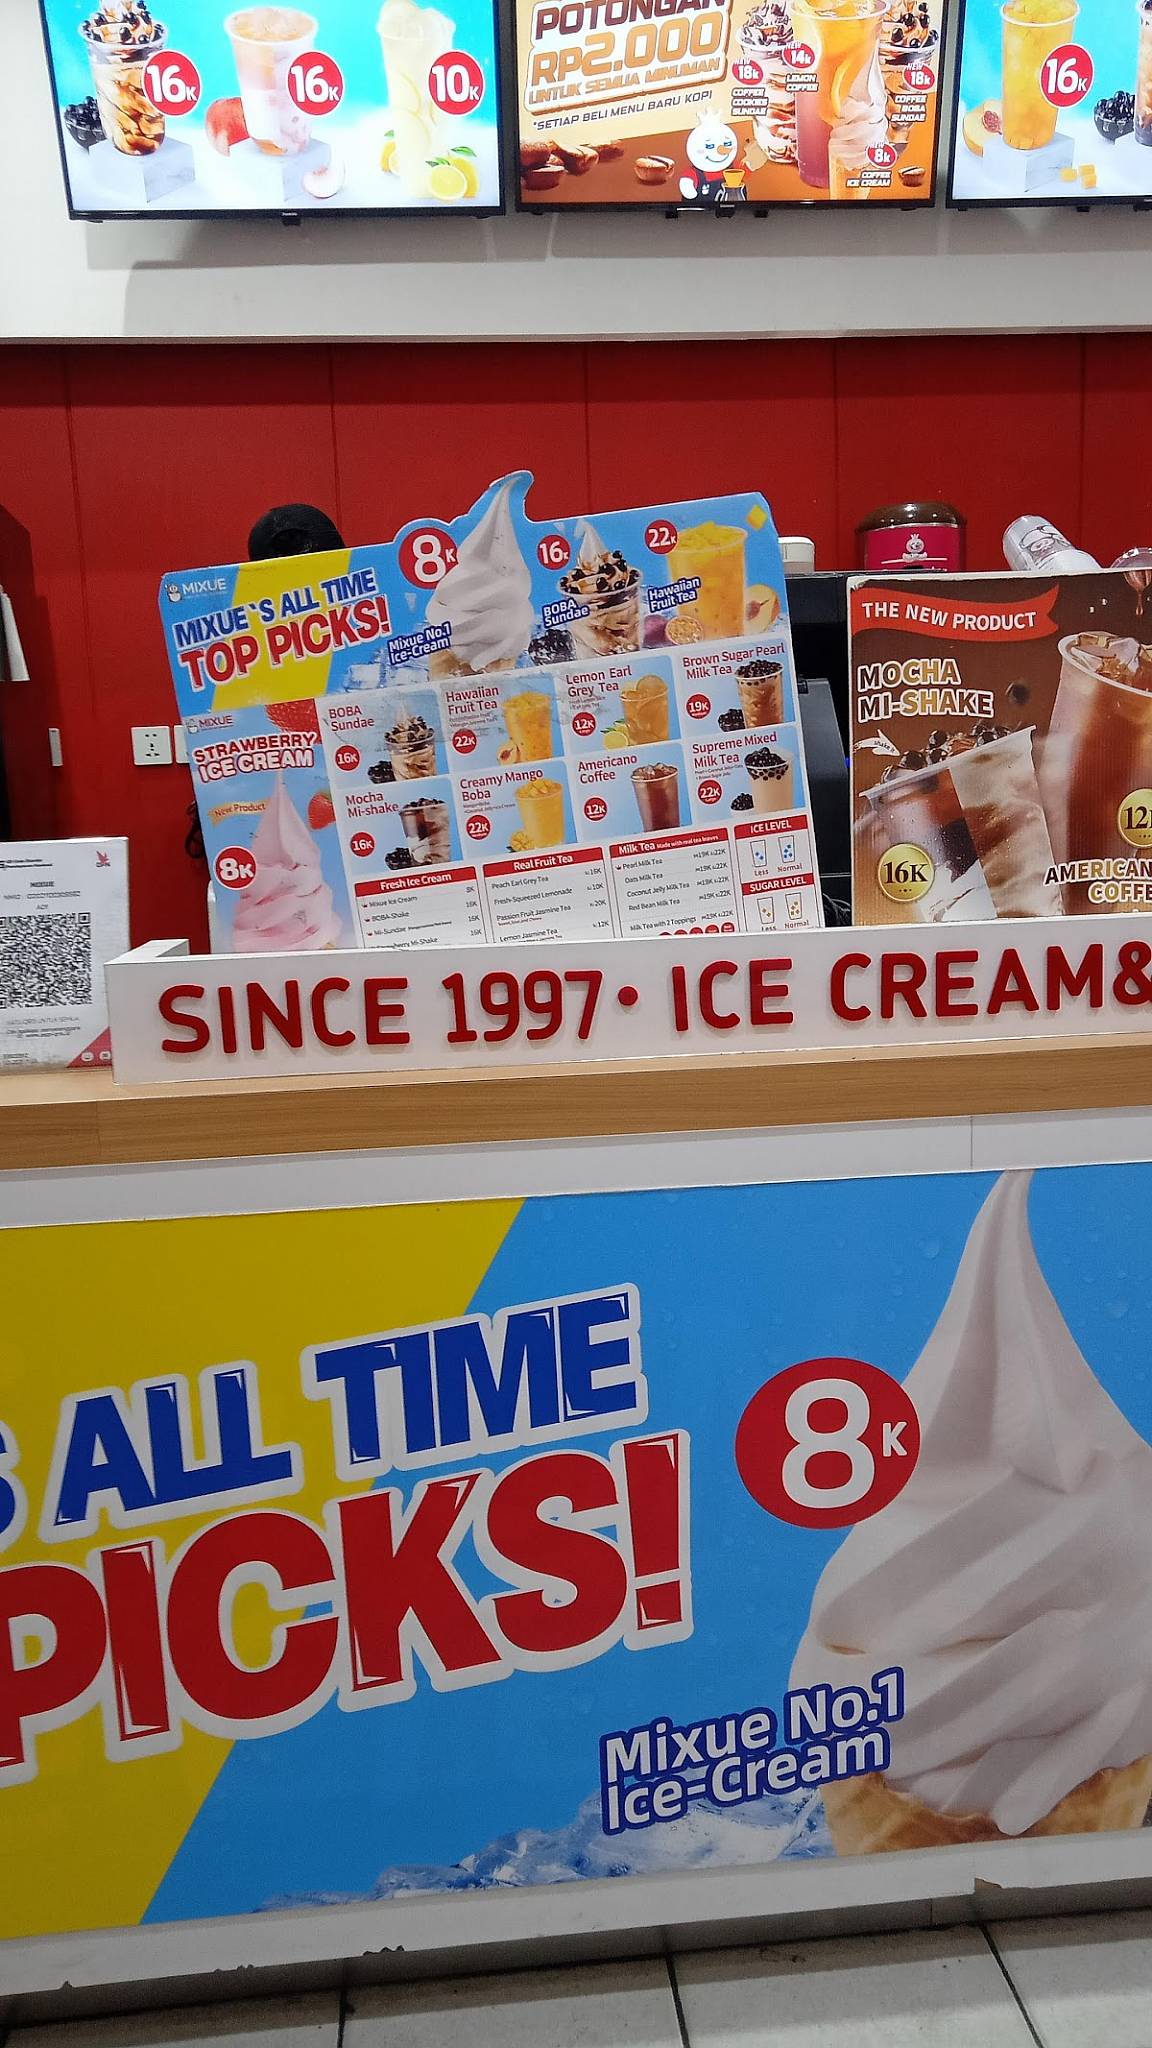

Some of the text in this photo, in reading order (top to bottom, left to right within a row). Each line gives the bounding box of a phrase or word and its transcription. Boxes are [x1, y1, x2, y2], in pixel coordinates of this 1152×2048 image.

[531, 11, 723, 86] RP2.000
[529, 57, 720, 105] UNTUK SEMUA MINUMAN
[1046, 57, 1088, 94] 16K
[146, 66, 197, 103] 16K
[291, 66, 340, 102] 16K
[431, 66, 479, 102] 10K
[582, 108, 608, 123] BELI
[610, 103, 645, 117] MENU
[648, 96, 680, 111] BARU
[684, 90, 713, 104] KOPI
[895, 95, 927, 103] COFFEE
[861, 179, 891, 187] CREAM
[862, 171, 891, 179] COFFEE
[649, 529, 677, 548] 22K
[412, 534, 456, 583] 8K
[539, 541, 569, 564] 16K
[182, 578, 226, 594] MIXUE
[281, 589, 319, 618] ALL
[321, 569, 376, 605] TIME
[649, 577, 700, 600] Hawaiian
[543, 600, 576, 617] BOBA
[651, 589, 697, 612] Fruit Tea
[544, 605, 589, 627] Sundae
[862, 602, 1036, 631] THE NEW PRODUCT
[180, 596, 390, 689] TOP PICKS!
[388, 623, 451, 653] Mixue No.1
[683, 643, 785, 667] Brown Sugar Pearl
[566, 665, 632, 685] Lemon Earl
[686, 665, 733, 680] Milk Tea
[859, 658, 961, 692] MOCHA
[446, 686, 499, 703] Hawaiian
[568, 682, 619, 698] Grey Tea
[329, 705, 362, 719] BOBA
[448, 700, 498, 715] Fruit Tea
[689, 702, 709, 713] 19K
[859, 689, 994, 723] MI-SHAKE
[199, 715, 233, 728] MIXUE
[331, 718, 375, 732] Sundae
[575, 720, 595, 730] 12K
[193, 732, 316, 765] STRAWBERRY
[455, 736, 476, 747] 22K
[692, 731, 777, 754] Supreme Mixed
[199, 748, 314, 783] ICE CREAM
[337, 753, 358, 765] 16K
[578, 755, 638, 772] Americano
[694, 753, 739, 768] Milk Tea
[460, 769, 543, 789] Creamy Mango
[580, 771, 616, 784] Coffee
[345, 792, 384, 806] Mocha
[462, 789, 491, 801] Boba
[700, 787, 720, 799] 22K
[234, 802, 266, 813] Product
[347, 802, 399, 818] Mi-shake
[585, 804, 606, 815] 12K
[1123, 806, 1152, 830] 12
[468, 823, 489, 834] 22K
[750, 820, 791, 834] ICE LEVEL
[352, 840, 373, 851] 16K
[619, 842, 656, 855] Milk Tea
[219, 857, 254, 882] 8K
[514, 854, 573, 870] Real Fruit Tea
[622, 858, 662, 870] Pearl Milk Tea
[777, 863, 803, 872] Normal
[639, 874, 651, 882] Milk
[884, 860, 928, 885] 16K
[380, 873, 451, 890] Fresh Ice Cream
[492, 875, 549, 889] Peach Earl Grey Tea
[750, 877, 806, 892] SUGAR LEVEL
[541, 888, 573, 898] Lemonade
[627, 888, 652, 898] Coconut
[629, 903, 640, 911] Red
[641, 901, 656, 910] Bean
[669, 898, 680, 906] Tea
[497, 911, 520, 921] Passion
[630, 923, 642, 931] Milk
[643, 922, 653, 930] Tea
[671, 917, 696, 927] Toppings
[784, 920, 810, 929] Normal
[500, 934, 521, 943] Lemon
[522, 930, 546, 939] Jasmine
[158, 976, 412, 1054] SINCE
[671, 958, 793, 1032] ICE
[830, 941, 1152, 1021] CREAM&
[53, 1368, 293, 1527] ALL
[315, 1291, 637, 1465] TIME
[782, 1378, 907, 1508] 8K
[0, 1432, 682, 1767] PICKS!
[606, 1671, 901, 1782] Mixue No.1
[606, 1731, 884, 1830] Ice-Cream
